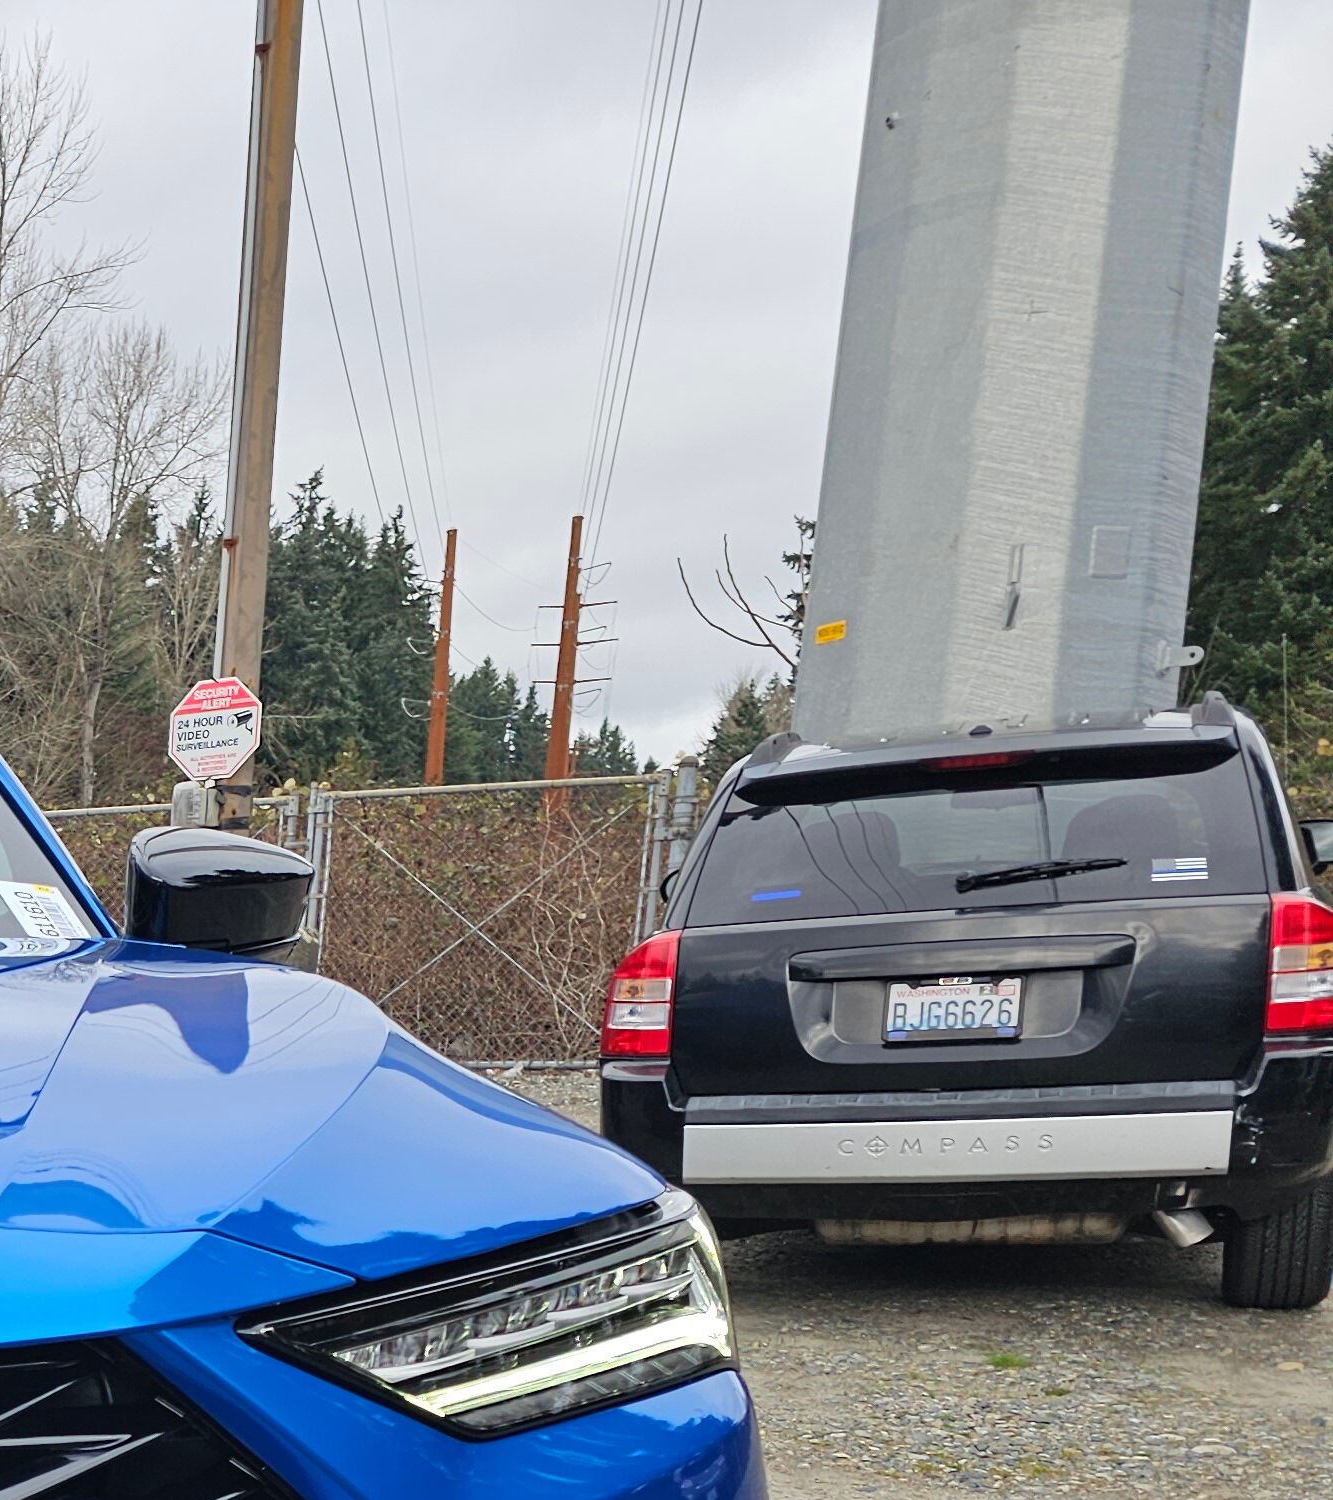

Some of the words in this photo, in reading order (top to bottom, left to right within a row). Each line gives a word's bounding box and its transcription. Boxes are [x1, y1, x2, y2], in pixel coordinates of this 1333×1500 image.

[193, 686, 240, 700] SECURITY
[201, 697, 232, 710] ALERT
[177, 720, 190, 730] 24
[193, 716, 223, 728] HOUR
[177, 730, 210, 741] VIDEO
[176, 738, 239, 752] SURVEILLANCE
[896, 986, 971, 999] WASHINGTON
[893, 998, 1013, 1029] BJG6626
[837, 1134, 1054, 1157] COMPASS
